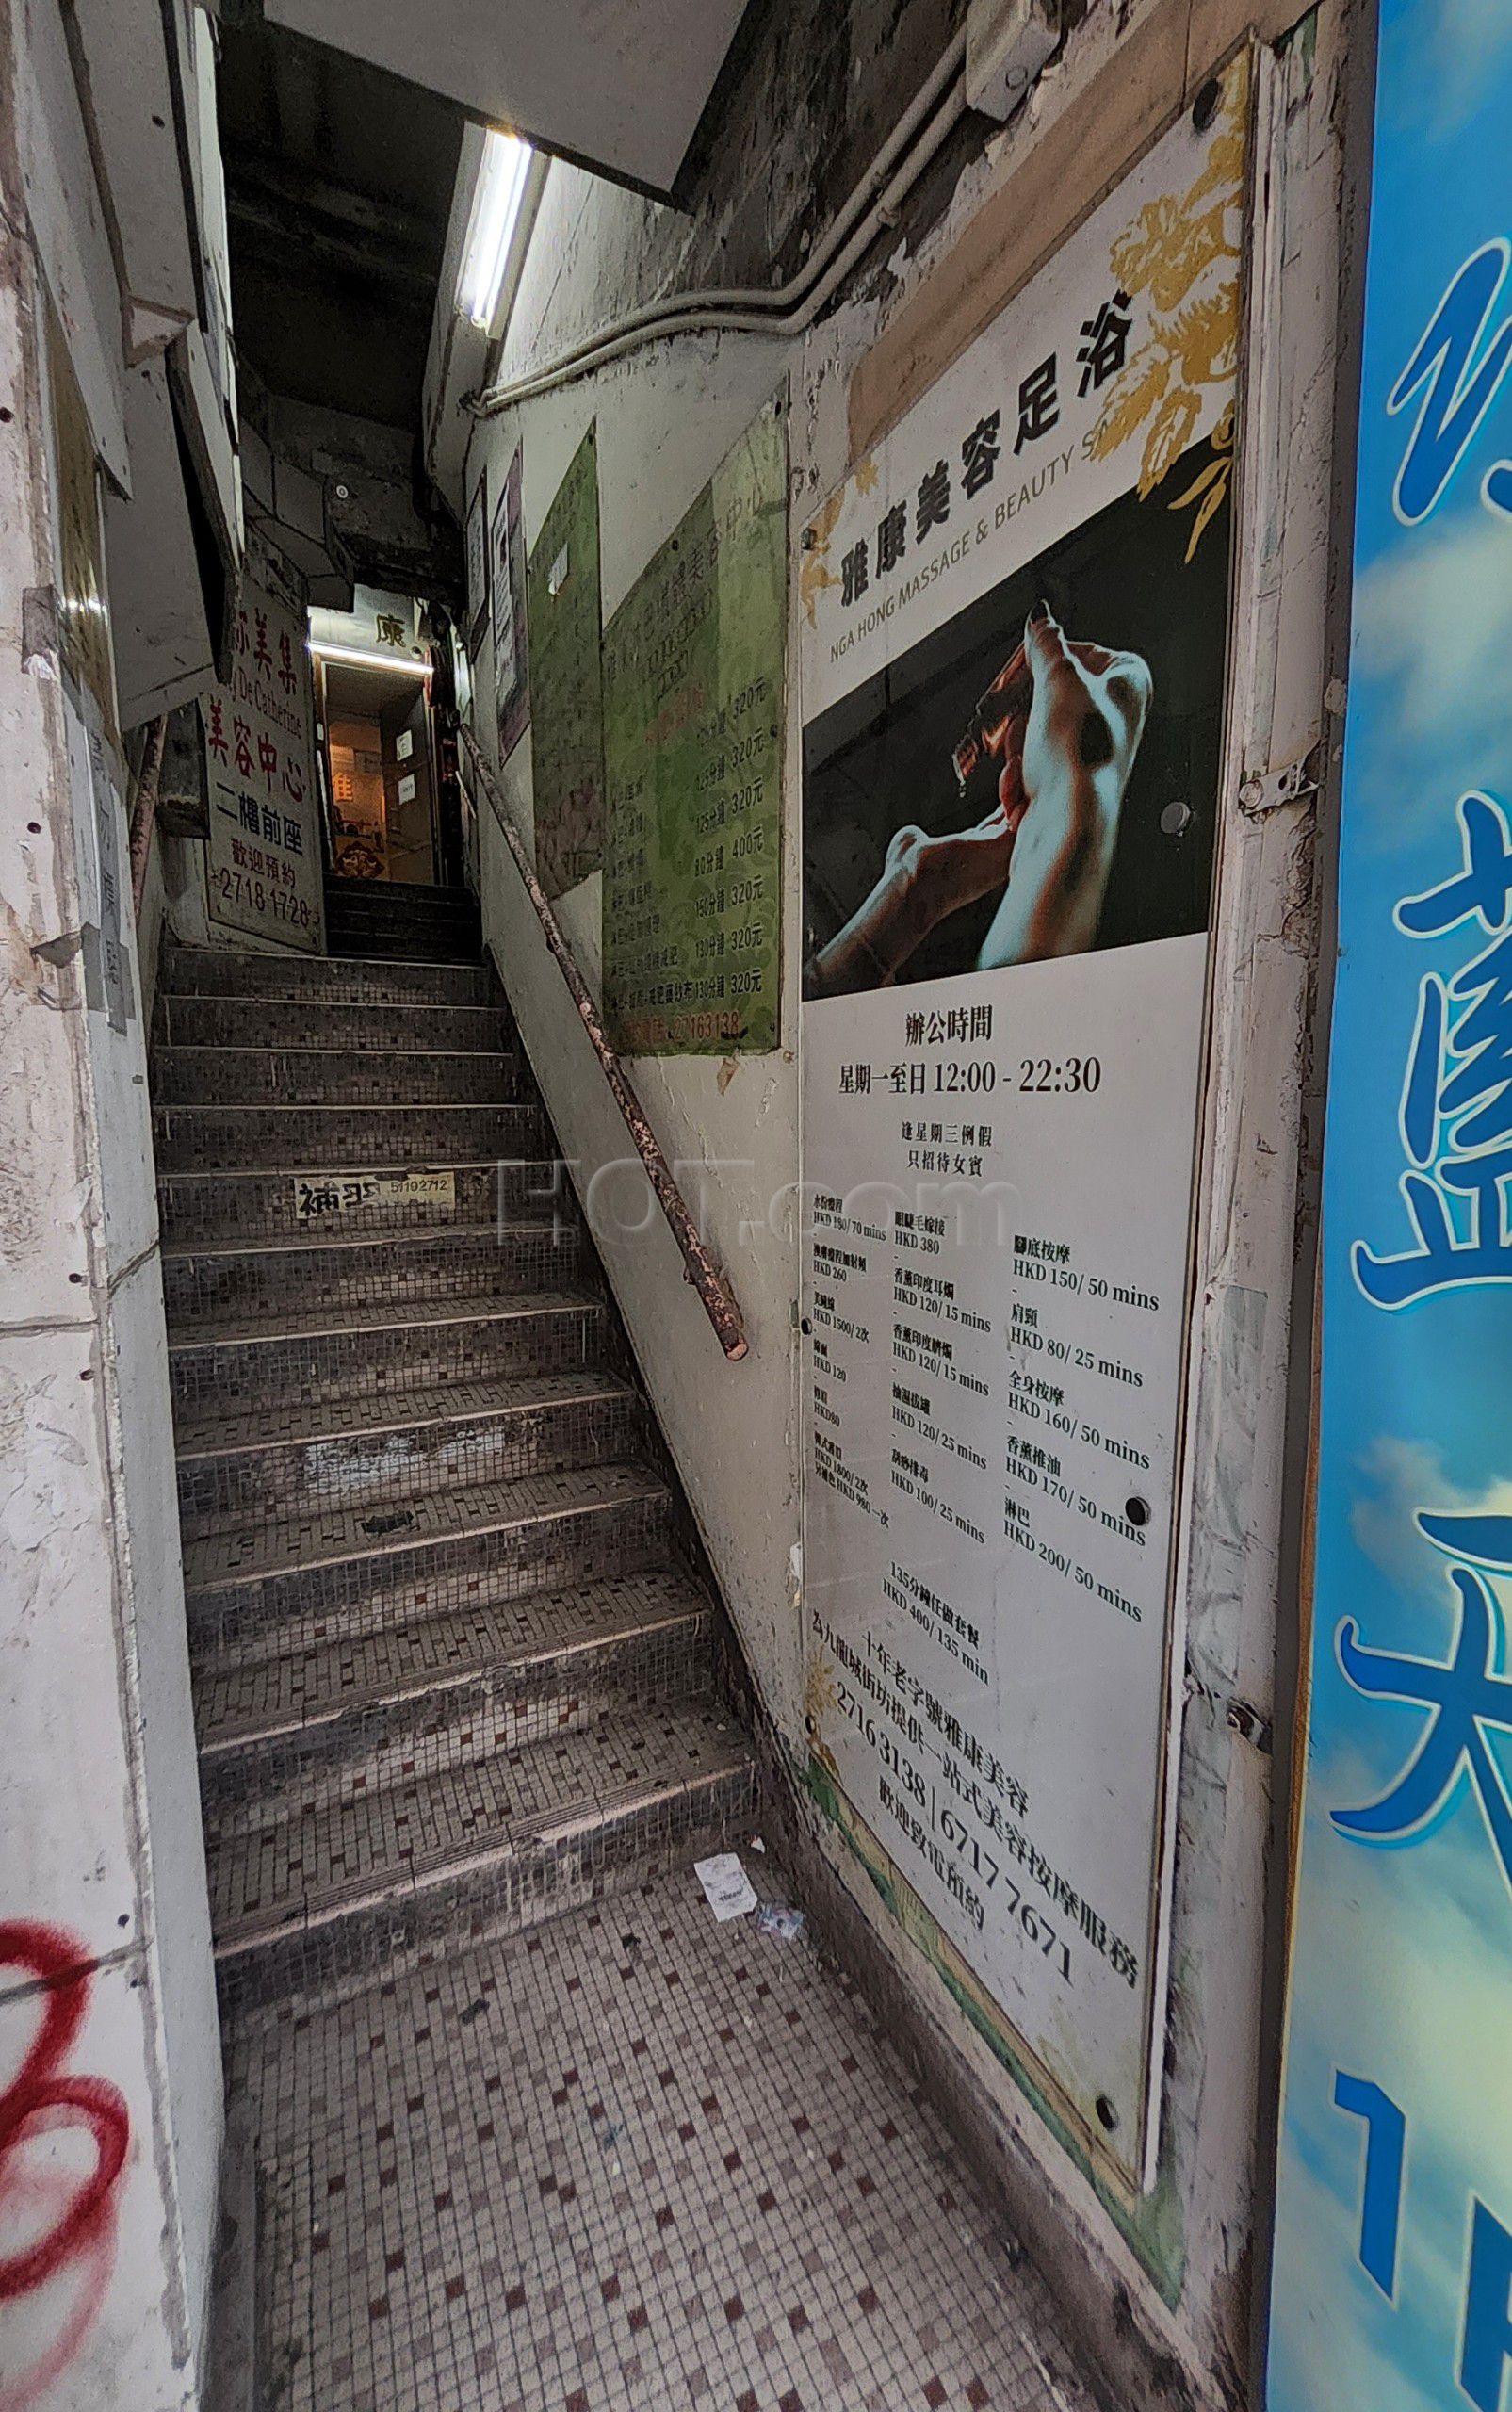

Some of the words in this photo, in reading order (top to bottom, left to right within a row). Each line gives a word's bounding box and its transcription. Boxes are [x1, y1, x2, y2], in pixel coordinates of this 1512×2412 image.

[841, 287, 1132, 608] 雅康美容足浴
[829, 634, 855, 663] NGA
[857, 598, 895, 638] HONG
[898, 530, 971, 611] MASSAGE
[975, 517, 990, 543] &
[994, 445, 1074, 528] BEAUTY
[208, 693, 307, 804] 美容中心
[731, 726, 765, 769] 320元
[216, 782, 303, 856] 二樓前座
[731, 777, 765, 815] 320元
[231, 838, 296, 889] 歡迎預約
[732, 831, 764, 859] 400元
[220, 867, 265, 912] 2718
[731, 874, 764, 907] 320元
[731, 921, 764, 951] 320元
[731, 969, 763, 994] 320元
[905, 1004, 994, 1047] 辦公時間
[838, 1061, 926, 1095] 星期一至日
[934, 1061, 996, 1094] 12:00
[1019, 1056, 1102, 1094] 22:30
[902, 1120, 993, 1149] 逢星期三例假
[906, 1149, 984, 1177] 只招待女賓
[813, 1211, 831, 1227] HKD
[852, 1220, 862, 1235] 70
[863, 1223, 886, 1242] mins
[894, 1230, 919, 1249] HKD
[920, 1236, 940, 1255] 380
[813, 1260, 831, 1278] HKD
[833, 1266, 847, 1283] 260
[1013, 1259, 1047, 1282] HKD
[1049, 1267, 1084, 1296] 150/
[1087, 1278, 1109, 1298] 50
[1113, 1284, 1160, 1312] mins
[813, 1308, 831, 1325] HKD
[855, 1326, 870, 1345] 2次
[893, 1285, 918, 1307] HKD
[919, 1296, 943, 1319] 120/
[945, 1304, 959, 1322] 15
[961, 1311, 992, 1333] mins
[813, 1355, 831, 1375] HKD
[833, 1365, 847, 1383] 120
[893, 1341, 917, 1364] HKD
[919, 1352, 941, 1377] 120/
[943, 1363, 957, 1382] 15
[959, 1373, 990, 1397] mins
[1010, 1326, 1044, 1352] HKD
[1047, 1339, 1071, 1365] 80/
[1074, 1348, 1095, 1370] 25
[1097, 1360, 1144, 1389] mins
[1008, 1369, 1065, 1408] 全身按摩
[891, 1405, 915, 1429] HKD
[917, 1419, 940, 1445] 120/
[941, 1432, 955, 1452] 25
[957, 1445, 988, 1471] mins
[1008, 1391, 1041, 1419] HKD
[1044, 1408, 1078, 1440] 160/
[1081, 1424, 1100, 1447] 50
[1104, 1440, 1151, 1470] mins
[815, 1447, 831, 1467] HKD
[854, 1476, 869, 1496] 2次
[837, 1478, 854, 1502] HKD
[871, 1506, 890, 1529] 一次
[890, 1470, 914, 1496] HKD
[916, 1487, 938, 1515] 100/
[939, 1503, 954, 1524] 25
[955, 1518, 985, 1545] mins
[1004, 1496, 1031, 1529] 淋巴
[1005, 1456, 1037, 1486] HKD
[1042, 1475, 1075, 1509] 170/
[1077, 1495, 1097, 1520] 50
[1100, 1515, 1146, 1548] mins
[1003, 1519, 1035, 1552] HKD
[1038, 1542, 1071, 1578] 200/
[1074, 1565, 1094, 1591] 50
[1097, 1582, 1143, 1623] mins
[882, 1578, 909, 1610] HKD
[909, 1604, 935, 1639] 400/
[936, 1626, 960, 1657] 135
[961, 1647, 990, 1687] min
[837, 1680, 877, 1747] 2716
[878, 1736, 926, 1809] 3138
[940, 1808, 1000, 1891] 6717
[1004, 1875, 1075, 1988] 7671
